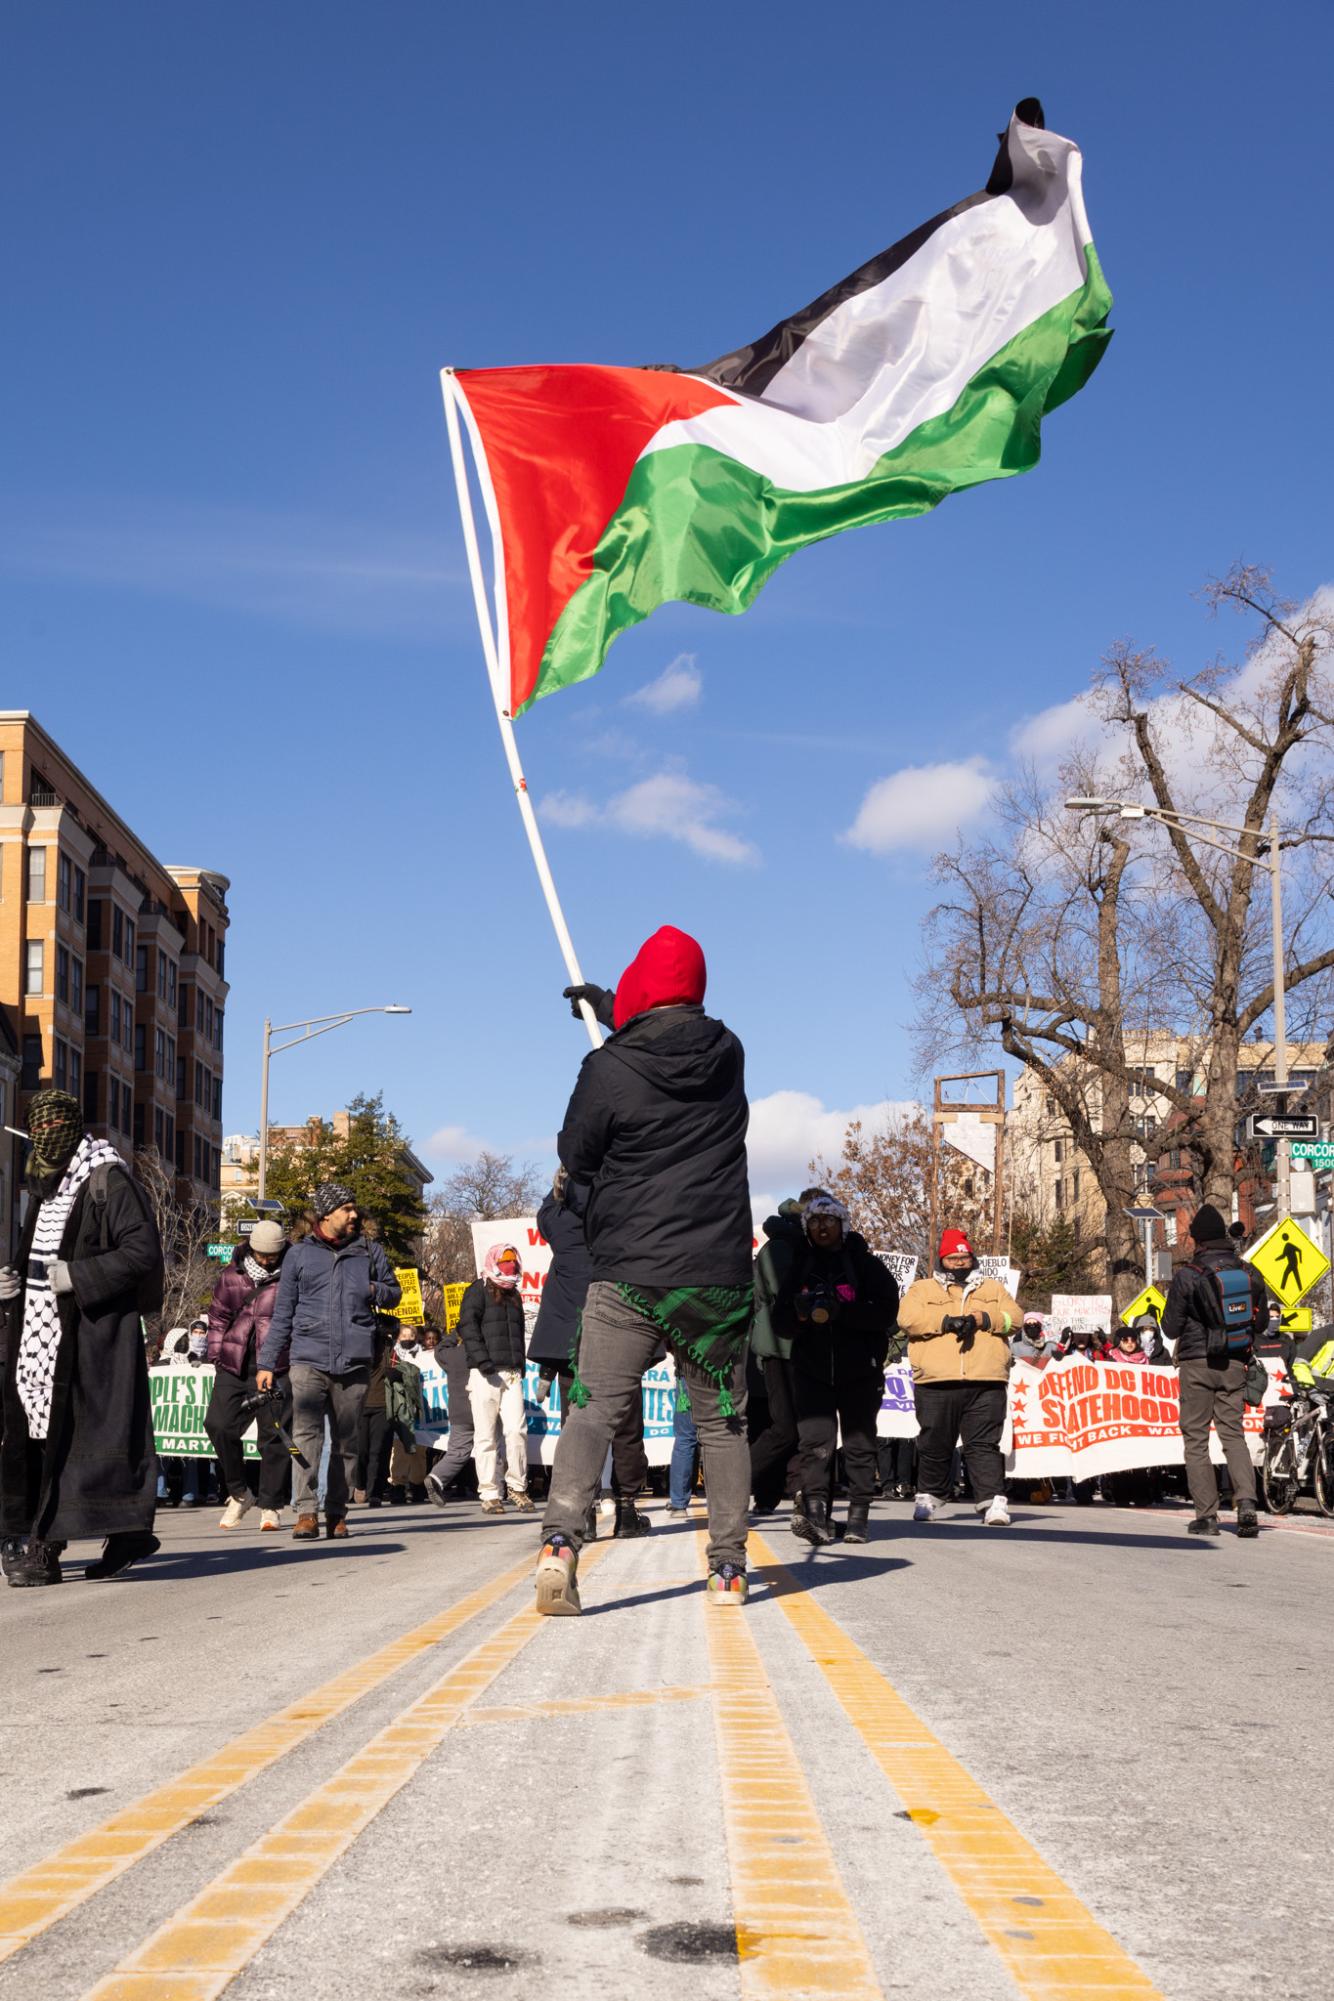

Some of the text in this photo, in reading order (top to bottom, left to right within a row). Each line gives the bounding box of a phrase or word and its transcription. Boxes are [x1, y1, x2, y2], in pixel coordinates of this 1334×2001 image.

[1272, 1120, 1310, 1130] ONE WAY
[900, 1257, 915, 1266] FOR
[885, 1263, 910, 1274] OPLE'S
[1038, 1365, 1099, 1401] DEFEND
[1104, 1368, 1136, 1393] DC
[1041, 1393, 1180, 1434] STATEHOOD
[649, 1427, 670, 1436] DC
[1018, 1433, 1043, 1445] WE
[1087, 1425, 1132, 1442] BACK
